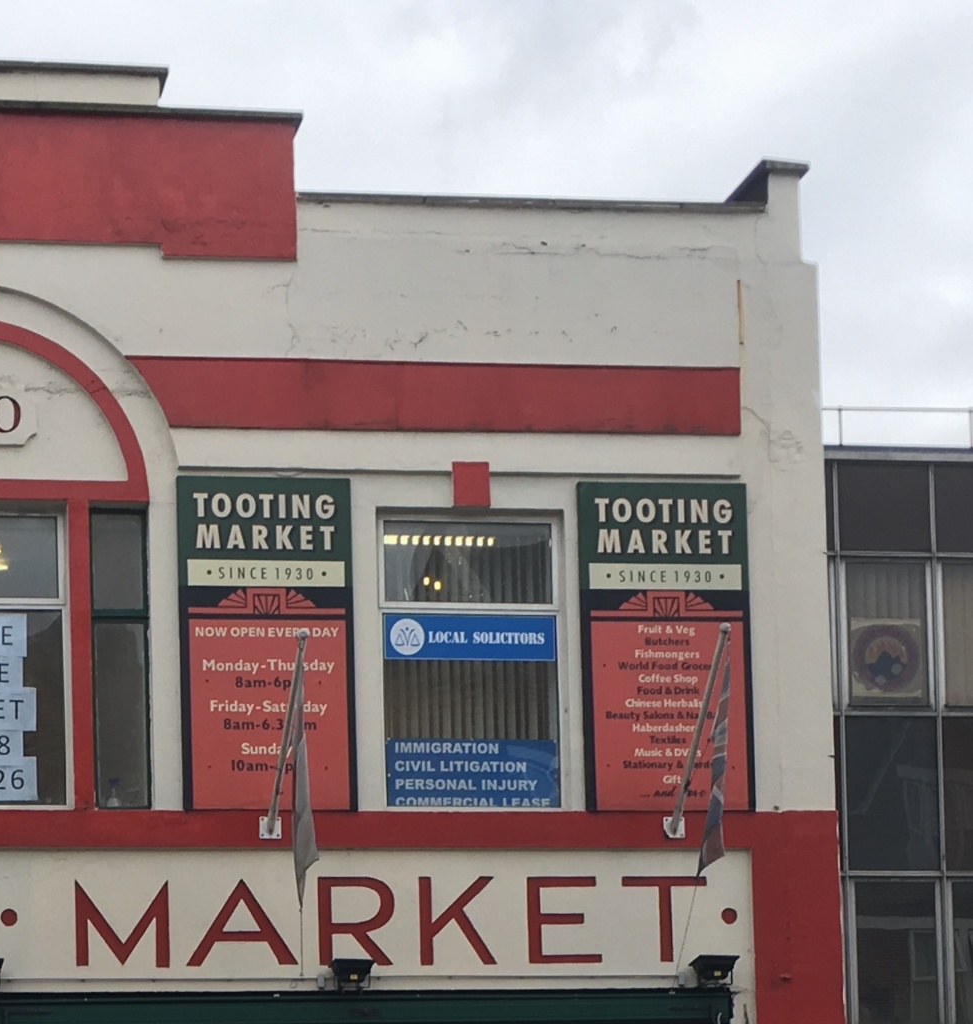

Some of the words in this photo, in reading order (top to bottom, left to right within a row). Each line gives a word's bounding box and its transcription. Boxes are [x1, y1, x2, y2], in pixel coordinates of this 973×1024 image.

[193, 492, 336, 519] TOOTING
[594, 497, 733, 523] TOOTING
[195, 523, 335, 550] MARKET
[597, 528, 733, 555] MARKET
[218, 566, 267, 580] SINCE
[275, 567, 314, 580] 1930
[619, 570, 667, 582] SINCE
[674, 571, 712, 583] 1930
[195, 626, 227, 637] NOW
[230, 627, 265, 637] OPEN
[637, 624, 662, 634] Fruit
[665, 625, 674, 634] &
[675, 625, 696, 637] Veg
[428, 630, 468, 644] LOCAL
[472, 631, 545, 645] SOLICITORS
[644, 637, 690, 646] Butchers
[635, 649, 700, 660] Fishmongers
[618, 661, 649, 671] World
[651, 661, 678, 671] Food
[235, 676, 293, 691] 8am-6p
[638, 674, 672, 683] Coffee
[673, 674, 698, 686] Shop
[637, 686, 662, 695] Food
[664, 687, 672, 695] &
[674, 687, 700, 696] Drink
[625, 698, 662, 708] Chinese
[605, 711, 640, 721] Beauty
[643, 711, 674, 720] Salons
[677, 711, 685, 720] &
[223, 718, 317, 731] 8am-6.3m
[649, 735, 686, 744] Textiles
[394, 742, 499, 754] IMMIGRATION
[634, 748, 663, 757] Music
[665, 748, 673, 757] &
[674, 748, 702, 757] DVs
[394, 760, 436, 772] CIVIL
[440, 761, 527, 773] LITIGATION
[623, 760, 672, 771] Stationary
[676, 761, 683, 769] &
[395, 778, 477, 790] PERSONAL
[481, 779, 538, 791] INJURY
[395, 797, 498, 806] COMMERCIAL
[503, 798, 550, 807] LEASE
[74, 875, 707, 969] MARKET
